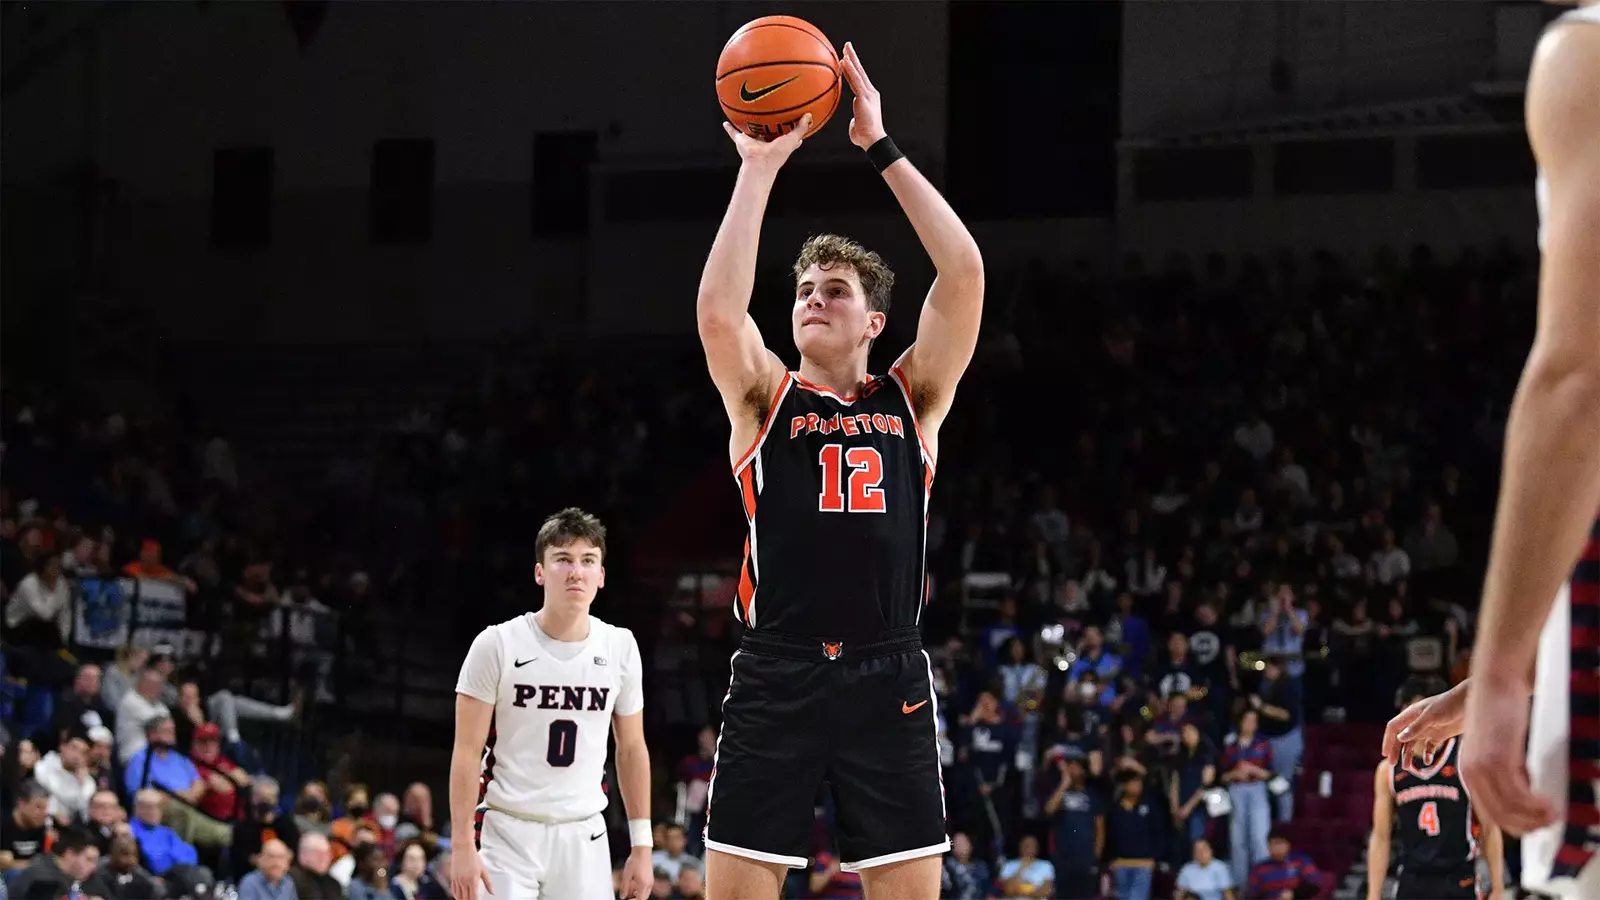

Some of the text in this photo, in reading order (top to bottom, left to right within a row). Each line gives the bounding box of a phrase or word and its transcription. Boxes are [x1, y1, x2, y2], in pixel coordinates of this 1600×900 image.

[748, 117, 804, 135] ELIT
[790, 412, 904, 439] PRINETON
[818, 444, 887, 513] 12
[513, 684, 610, 711] PENN
[547, 719, 578, 767] 0
[1418, 801, 1440, 836] 4
